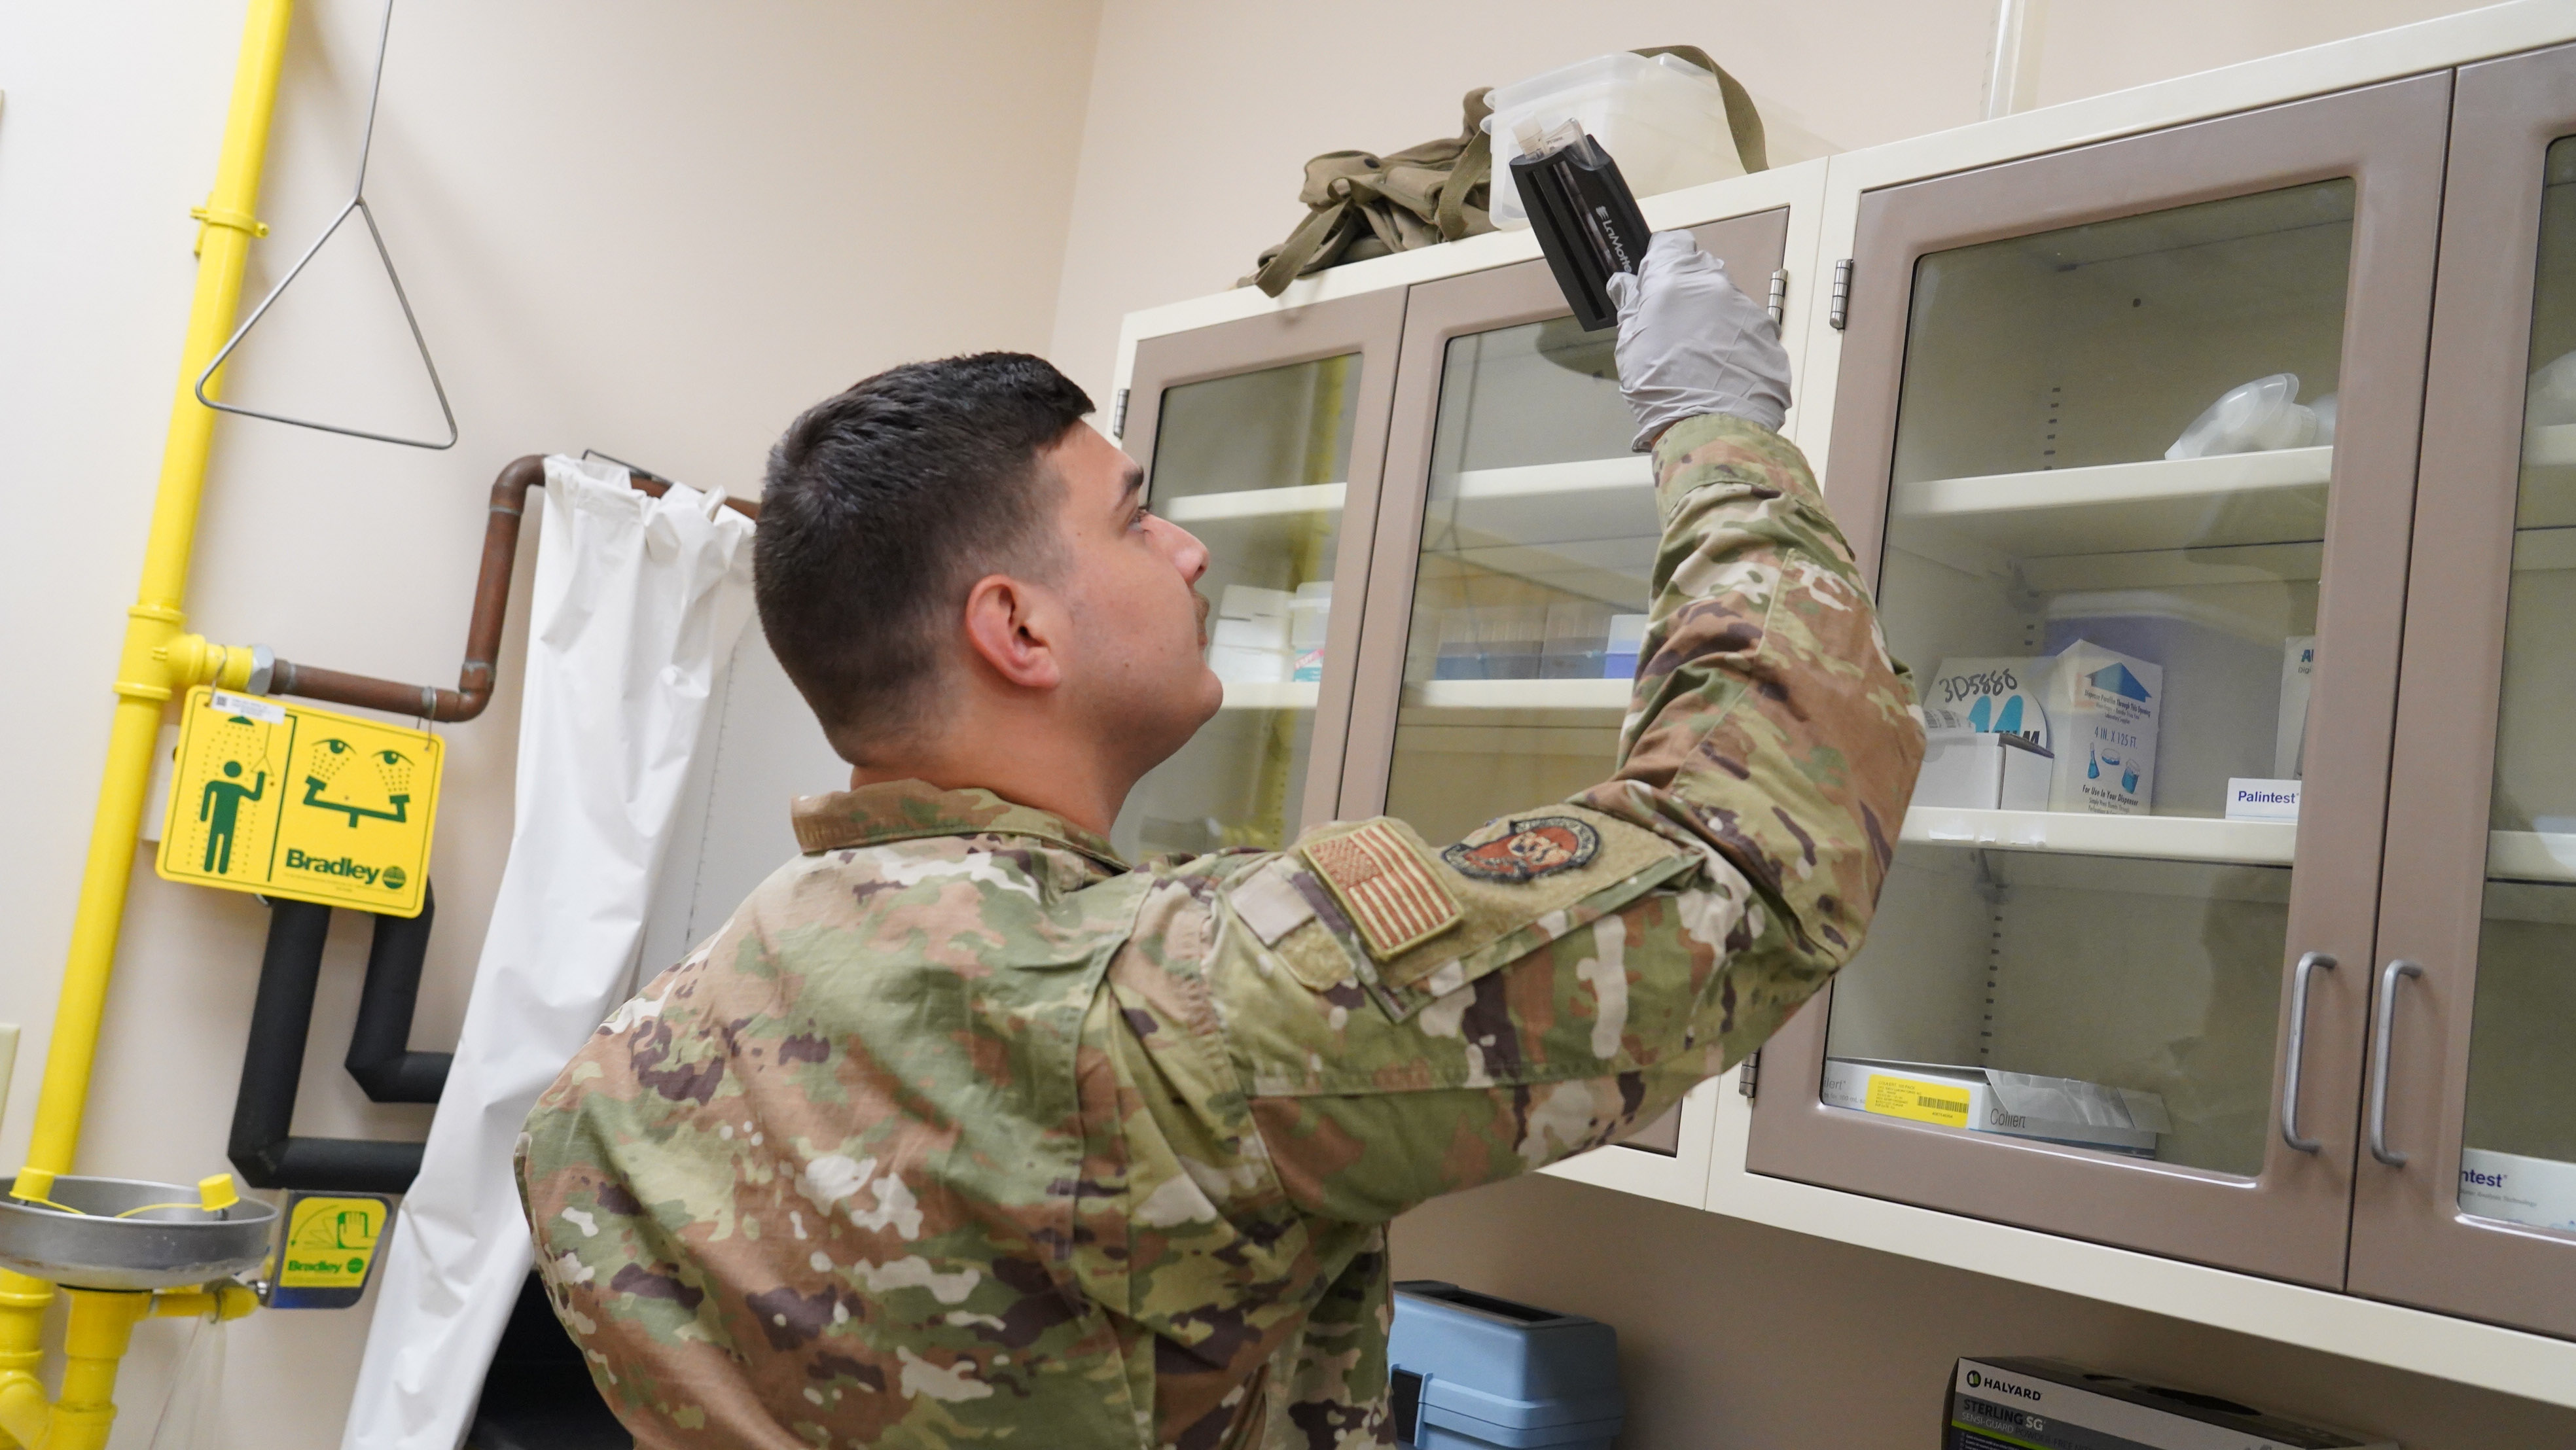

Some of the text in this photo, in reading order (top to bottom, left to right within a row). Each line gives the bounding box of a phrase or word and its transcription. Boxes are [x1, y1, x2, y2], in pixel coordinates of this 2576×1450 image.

[1602, 219, 1632, 273] LaMotte
[2094, 726, 2098, 737] 4
[2100, 727, 2109, 741] IN.
[2111, 731, 2115, 743] X
[2117, 732, 2128, 746] 125
[2091, 787, 2100, 796] Use
[2100, 789, 2105, 798] In
[2107, 790, 2117, 801] Your
[2118, 794, 2138, 806] Dispenser
[2238, 790, 2295, 804] Palintest
[285, 848, 380, 884] Bradley
[1824, 1077, 1842, 1091] ilert
[2460, 1169, 2502, 1188] ntest
[1984, 1377, 2041, 1401] HALYARD
[1961, 1412, 2014, 1434] SENSI-GUARD
[1963, 1399, 2043, 1432] STERLING SG
